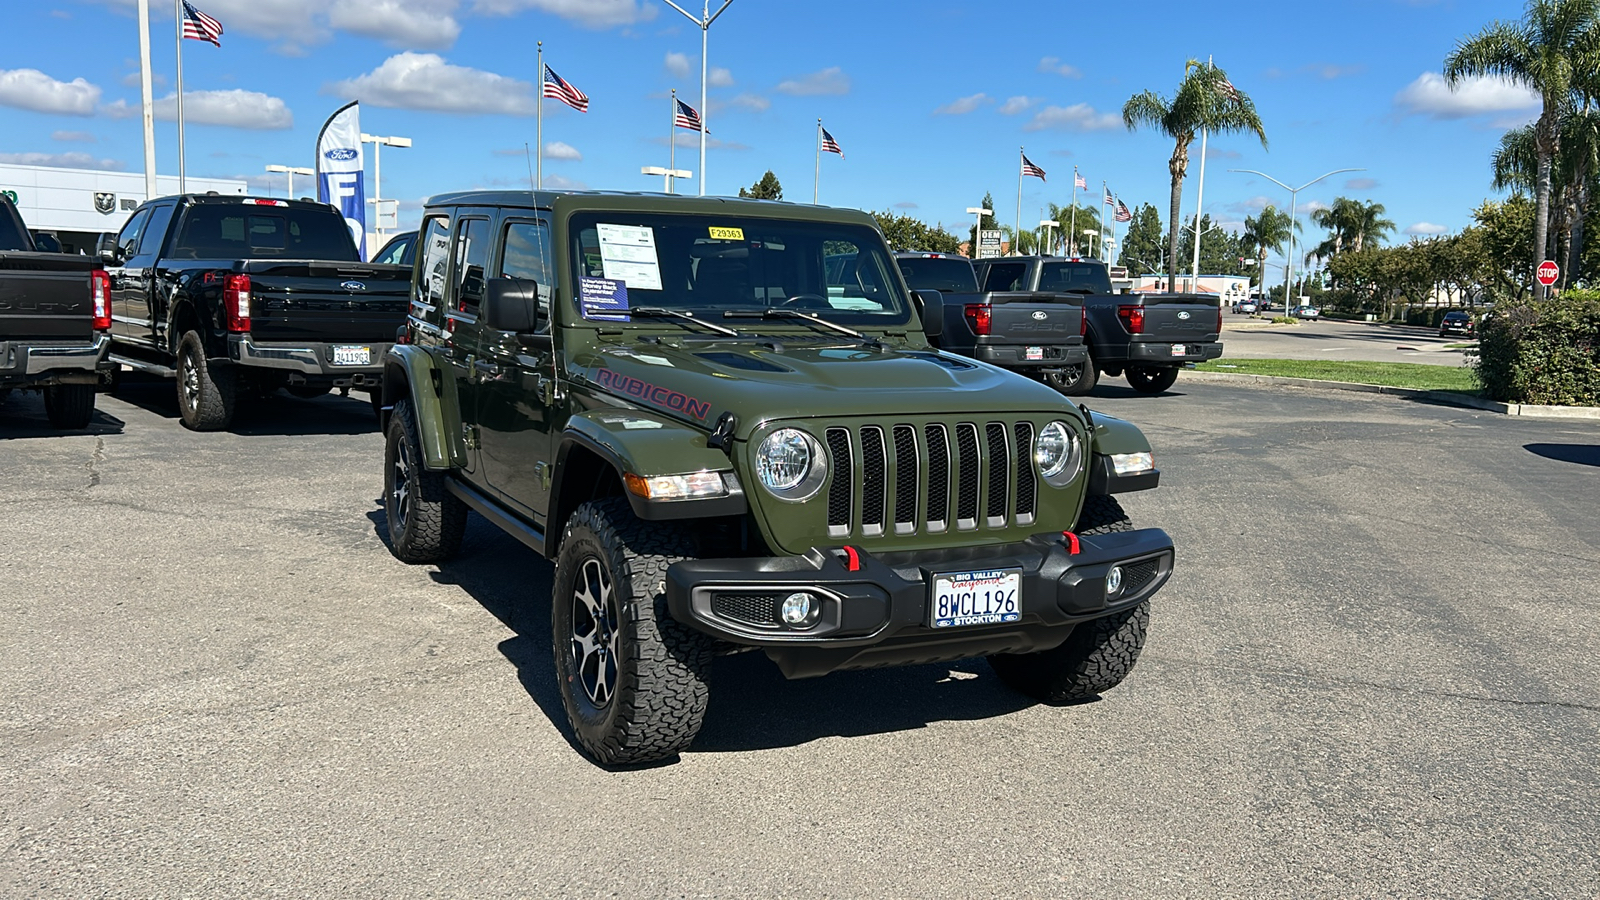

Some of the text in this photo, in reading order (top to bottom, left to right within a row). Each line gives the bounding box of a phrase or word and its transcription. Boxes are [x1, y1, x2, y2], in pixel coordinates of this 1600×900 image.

[330, 149, 355, 160] Ford
[711, 229, 742, 238] F29363
[982, 231, 1000, 239] OEM
[1538, 268, 1557, 278] STOP
[595, 368, 712, 420] RUBICON
[956, 571, 1002, 581] BIG VALLEY
[938, 589, 1016, 618] 8WCL196
[954, 613, 1002, 626] STOCKTON
